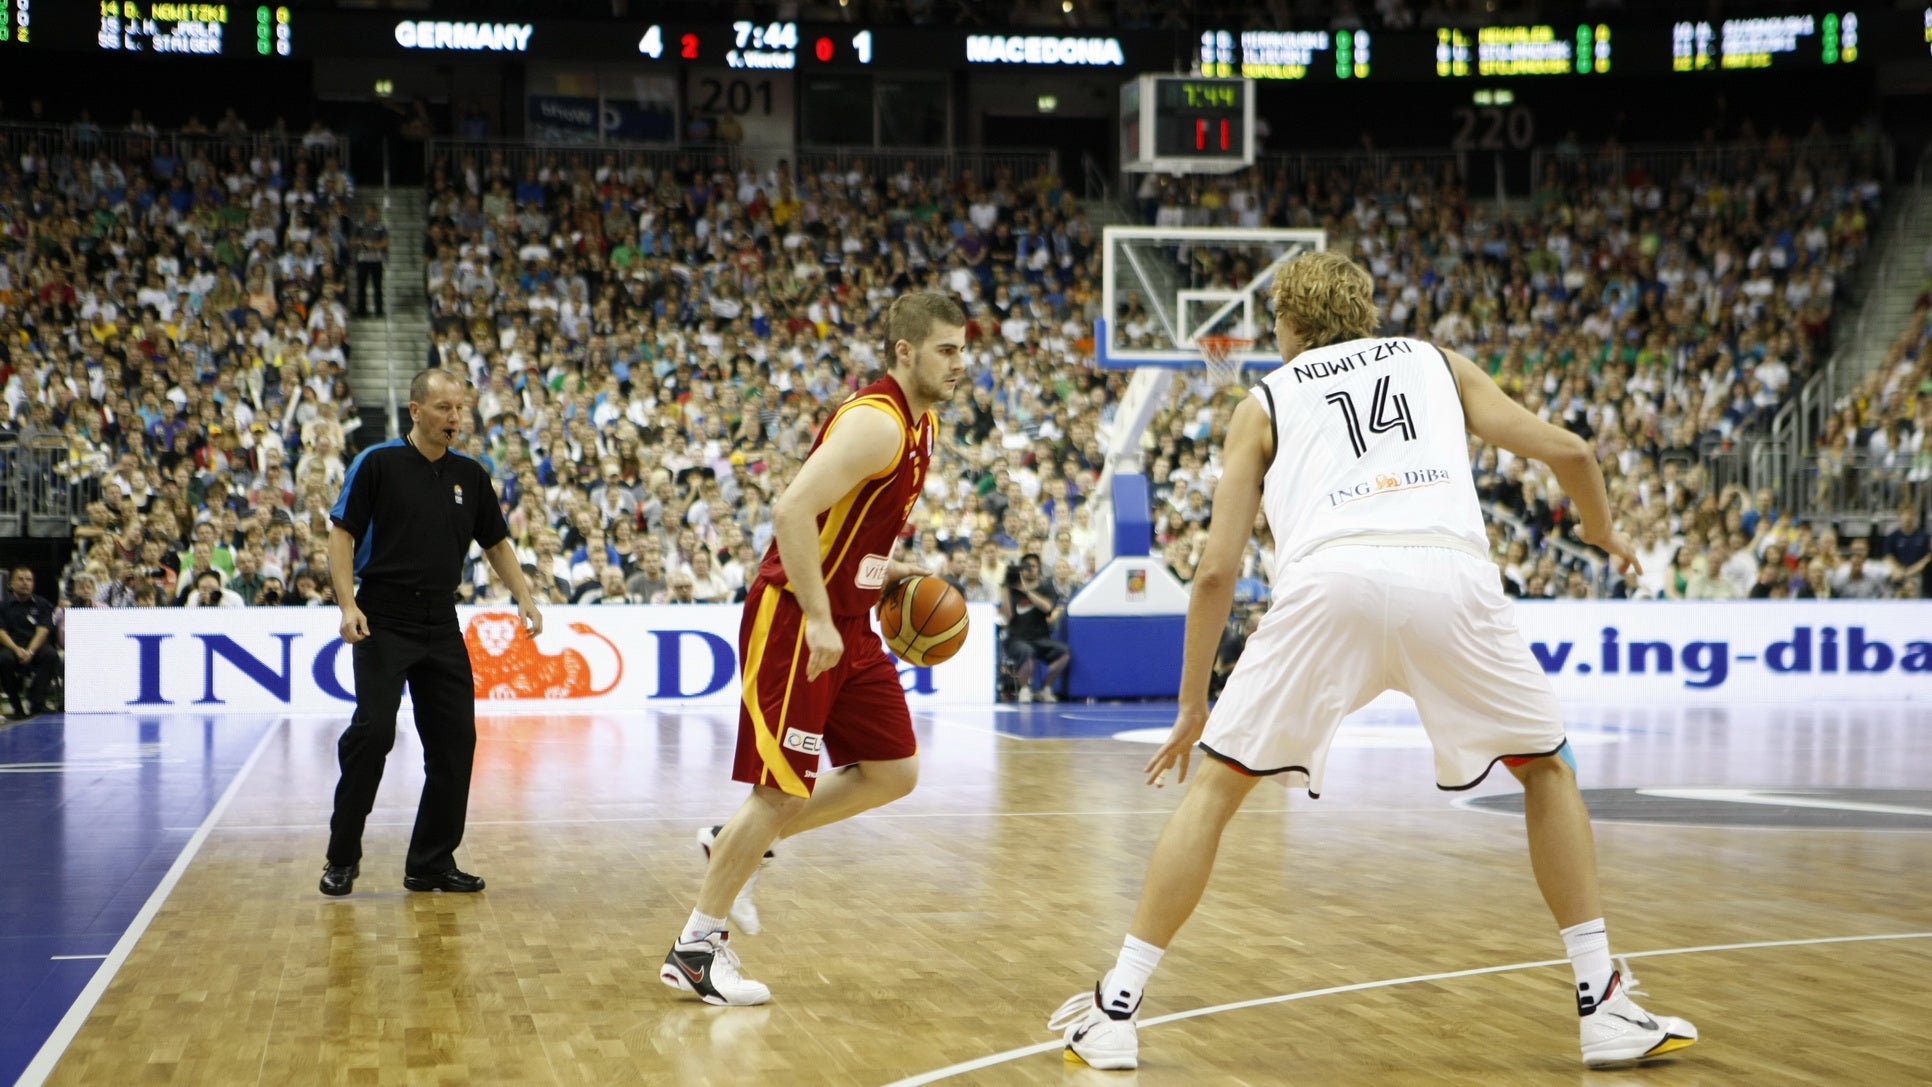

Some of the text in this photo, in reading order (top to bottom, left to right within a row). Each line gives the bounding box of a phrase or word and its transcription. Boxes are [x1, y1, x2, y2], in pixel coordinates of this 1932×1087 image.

[395, 20, 1125, 66] GERMANY 4 2 7:44 0 1 MACEDONIA
[701, 78, 773, 116] 201
[1182, 83, 1235, 107] 7:44
[1451, 105, 1536, 150] 220
[1293, 341, 1412, 383] NOWITZKI
[1325, 375, 1417, 459] 14
[1328, 469, 1450, 507] ING DiBa
